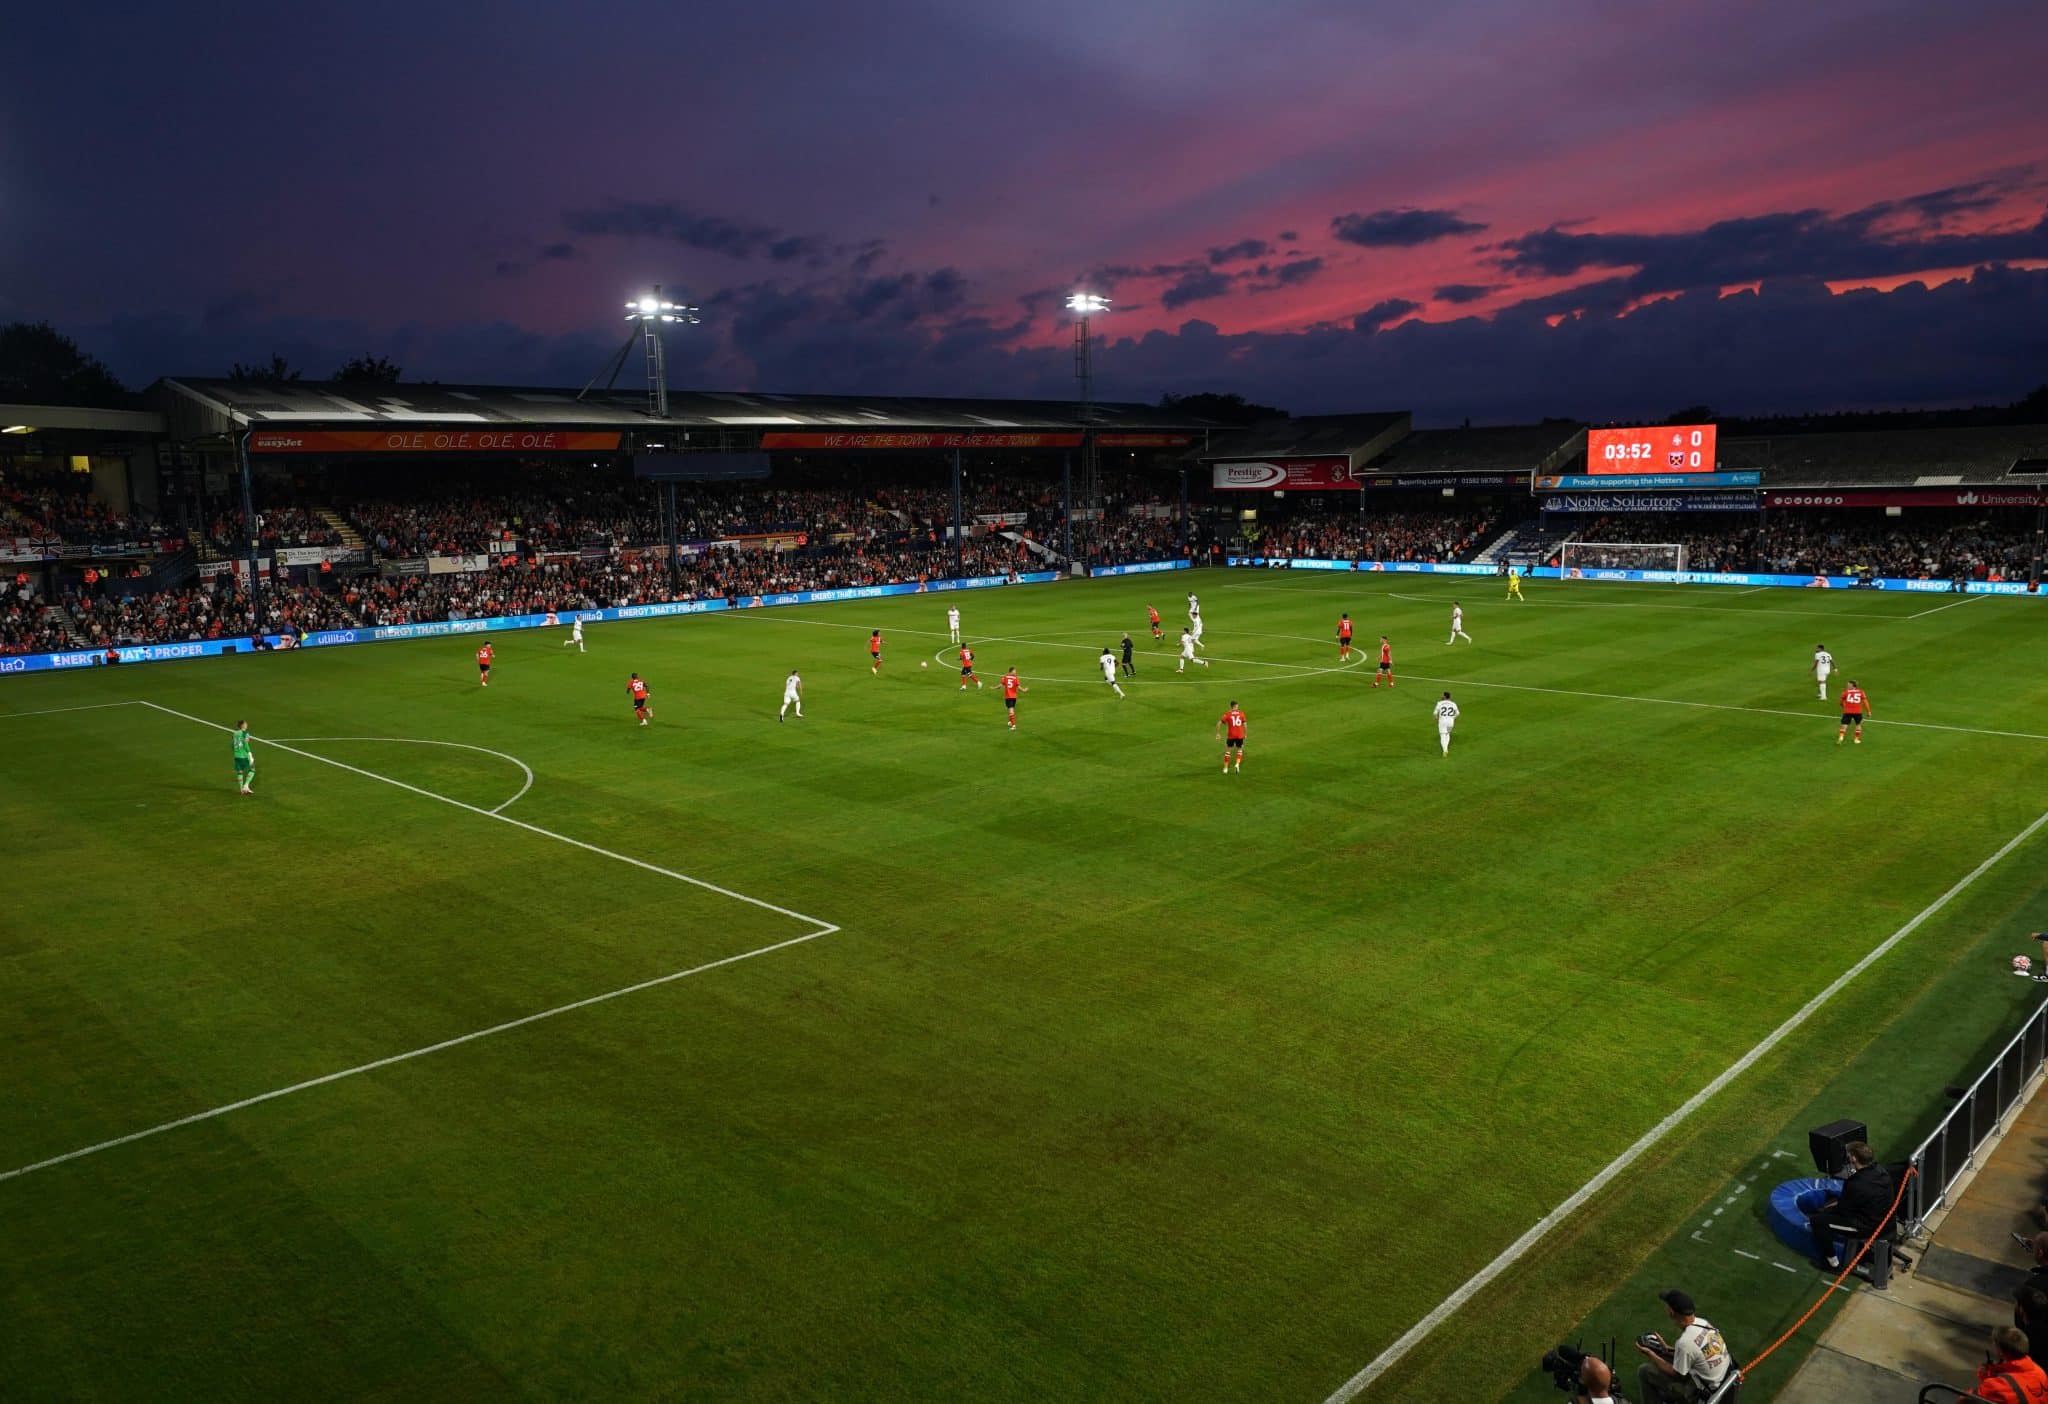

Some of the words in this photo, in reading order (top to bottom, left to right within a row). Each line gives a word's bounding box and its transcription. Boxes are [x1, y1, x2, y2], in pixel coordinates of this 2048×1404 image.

[257, 439, 303, 448] easyJet
[825, 435, 843, 446] WE
[846, 435, 870, 446] ARE
[873, 435, 896, 446] THE
[1691, 430, 1702, 447] 0
[1605, 443, 1652, 459] 03:52
[1690, 451, 1701, 467] 0
[1228, 467, 1262, 477] Prestige
[1572, 478, 1598, 487] Proudly
[1600, 478, 1638, 487] supporting
[1640, 477, 1652, 485] the
[1654, 476, 1683, 484] Hatters
[1563, 495, 1610, 507] Noble
[1613, 494, 1682, 508] Solicitors
[1982, 494, 2039, 506] University
[1713, 573, 1748, 583] PROPER
[1907, 581, 1949, 591] ENERGY
[618, 607, 649, 617] ENERGY
[651, 606, 676, 615] THAT'S
[678, 603, 705, 613] PROPER
[375, 627, 413, 639] ENERGY
[416, 624, 448, 635] THAT'S
[451, 621, 487, 632] PROPER
[318, 634, 347, 645] utilita
[155, 645, 202, 658] PROPER
[632, 682, 643, 691] 29
[1007, 680, 1013, 688] 5
[1846, 694, 1861, 703] 45
[1440, 706, 1454, 717] 22
[1231, 716, 1242, 726] 16
